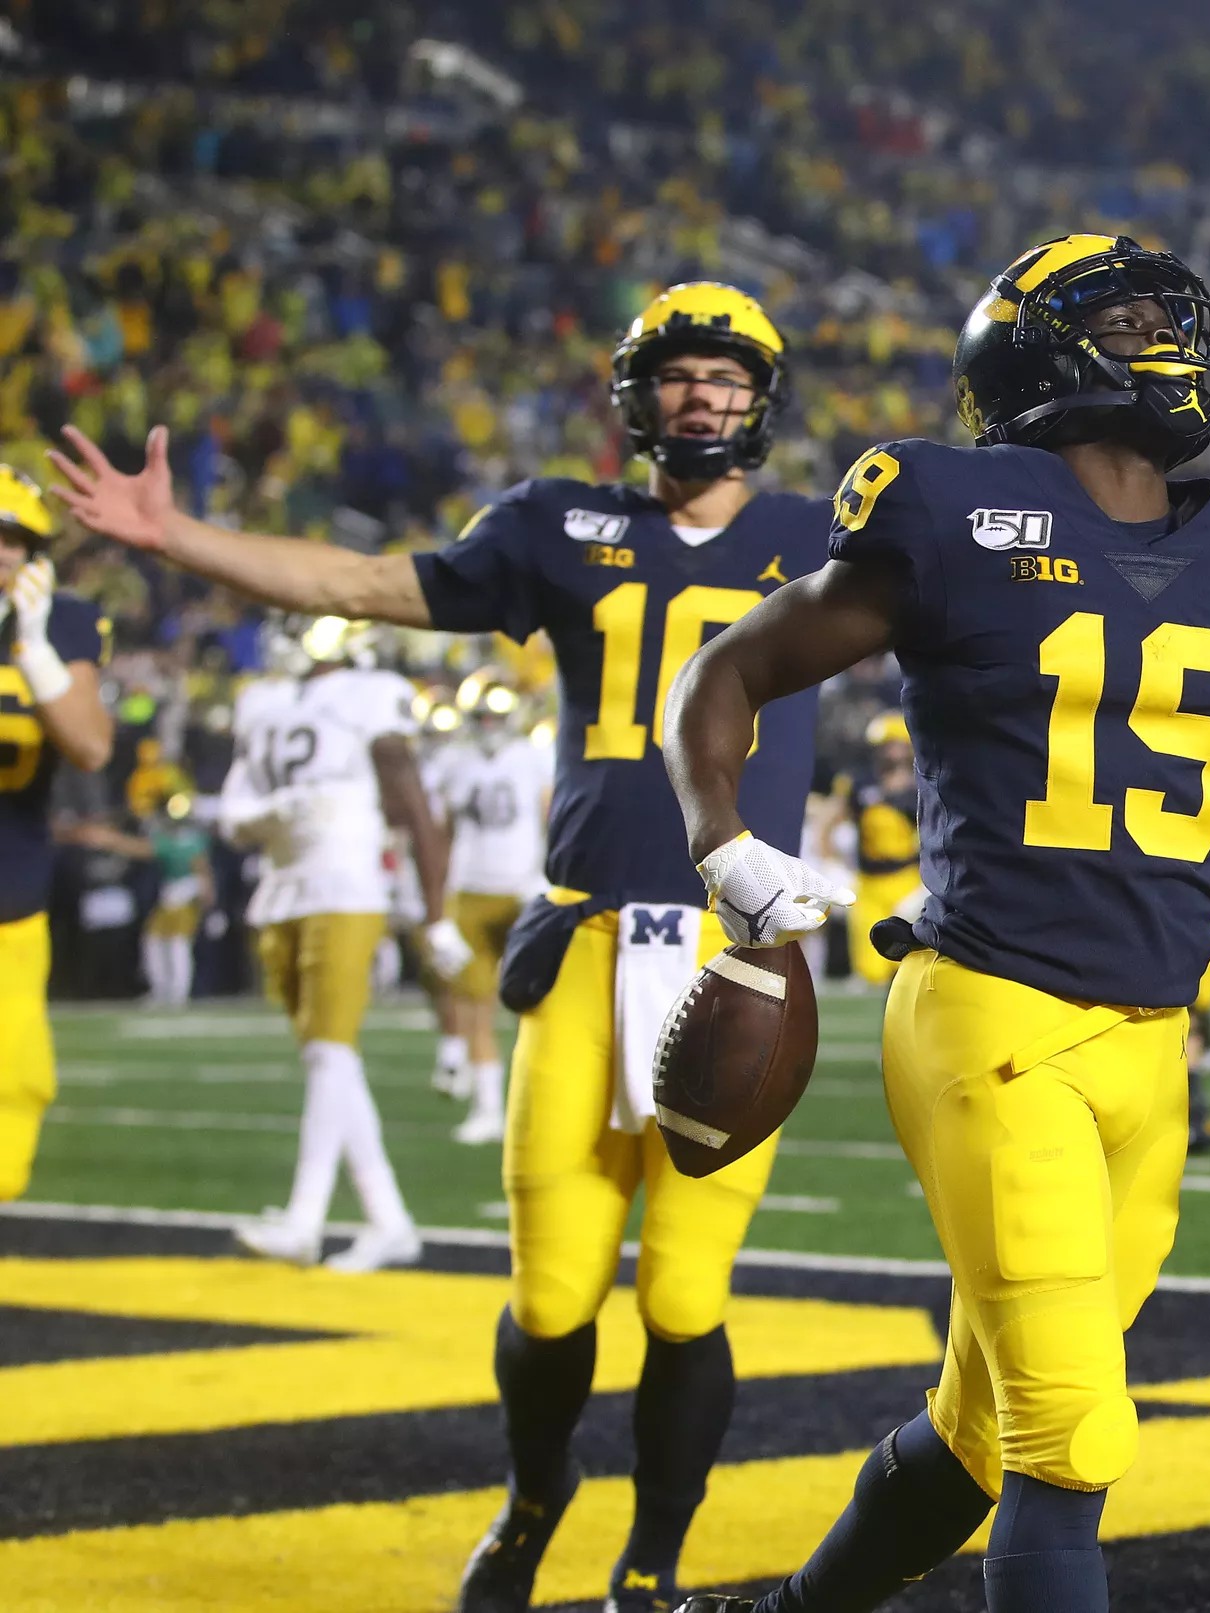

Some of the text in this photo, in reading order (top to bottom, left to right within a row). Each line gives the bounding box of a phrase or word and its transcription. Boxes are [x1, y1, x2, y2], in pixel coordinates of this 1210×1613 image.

[1027, 301, 1100, 358] ICHIAN
[967, 509, 1052, 550] 150
[630, 908, 683, 945] M
